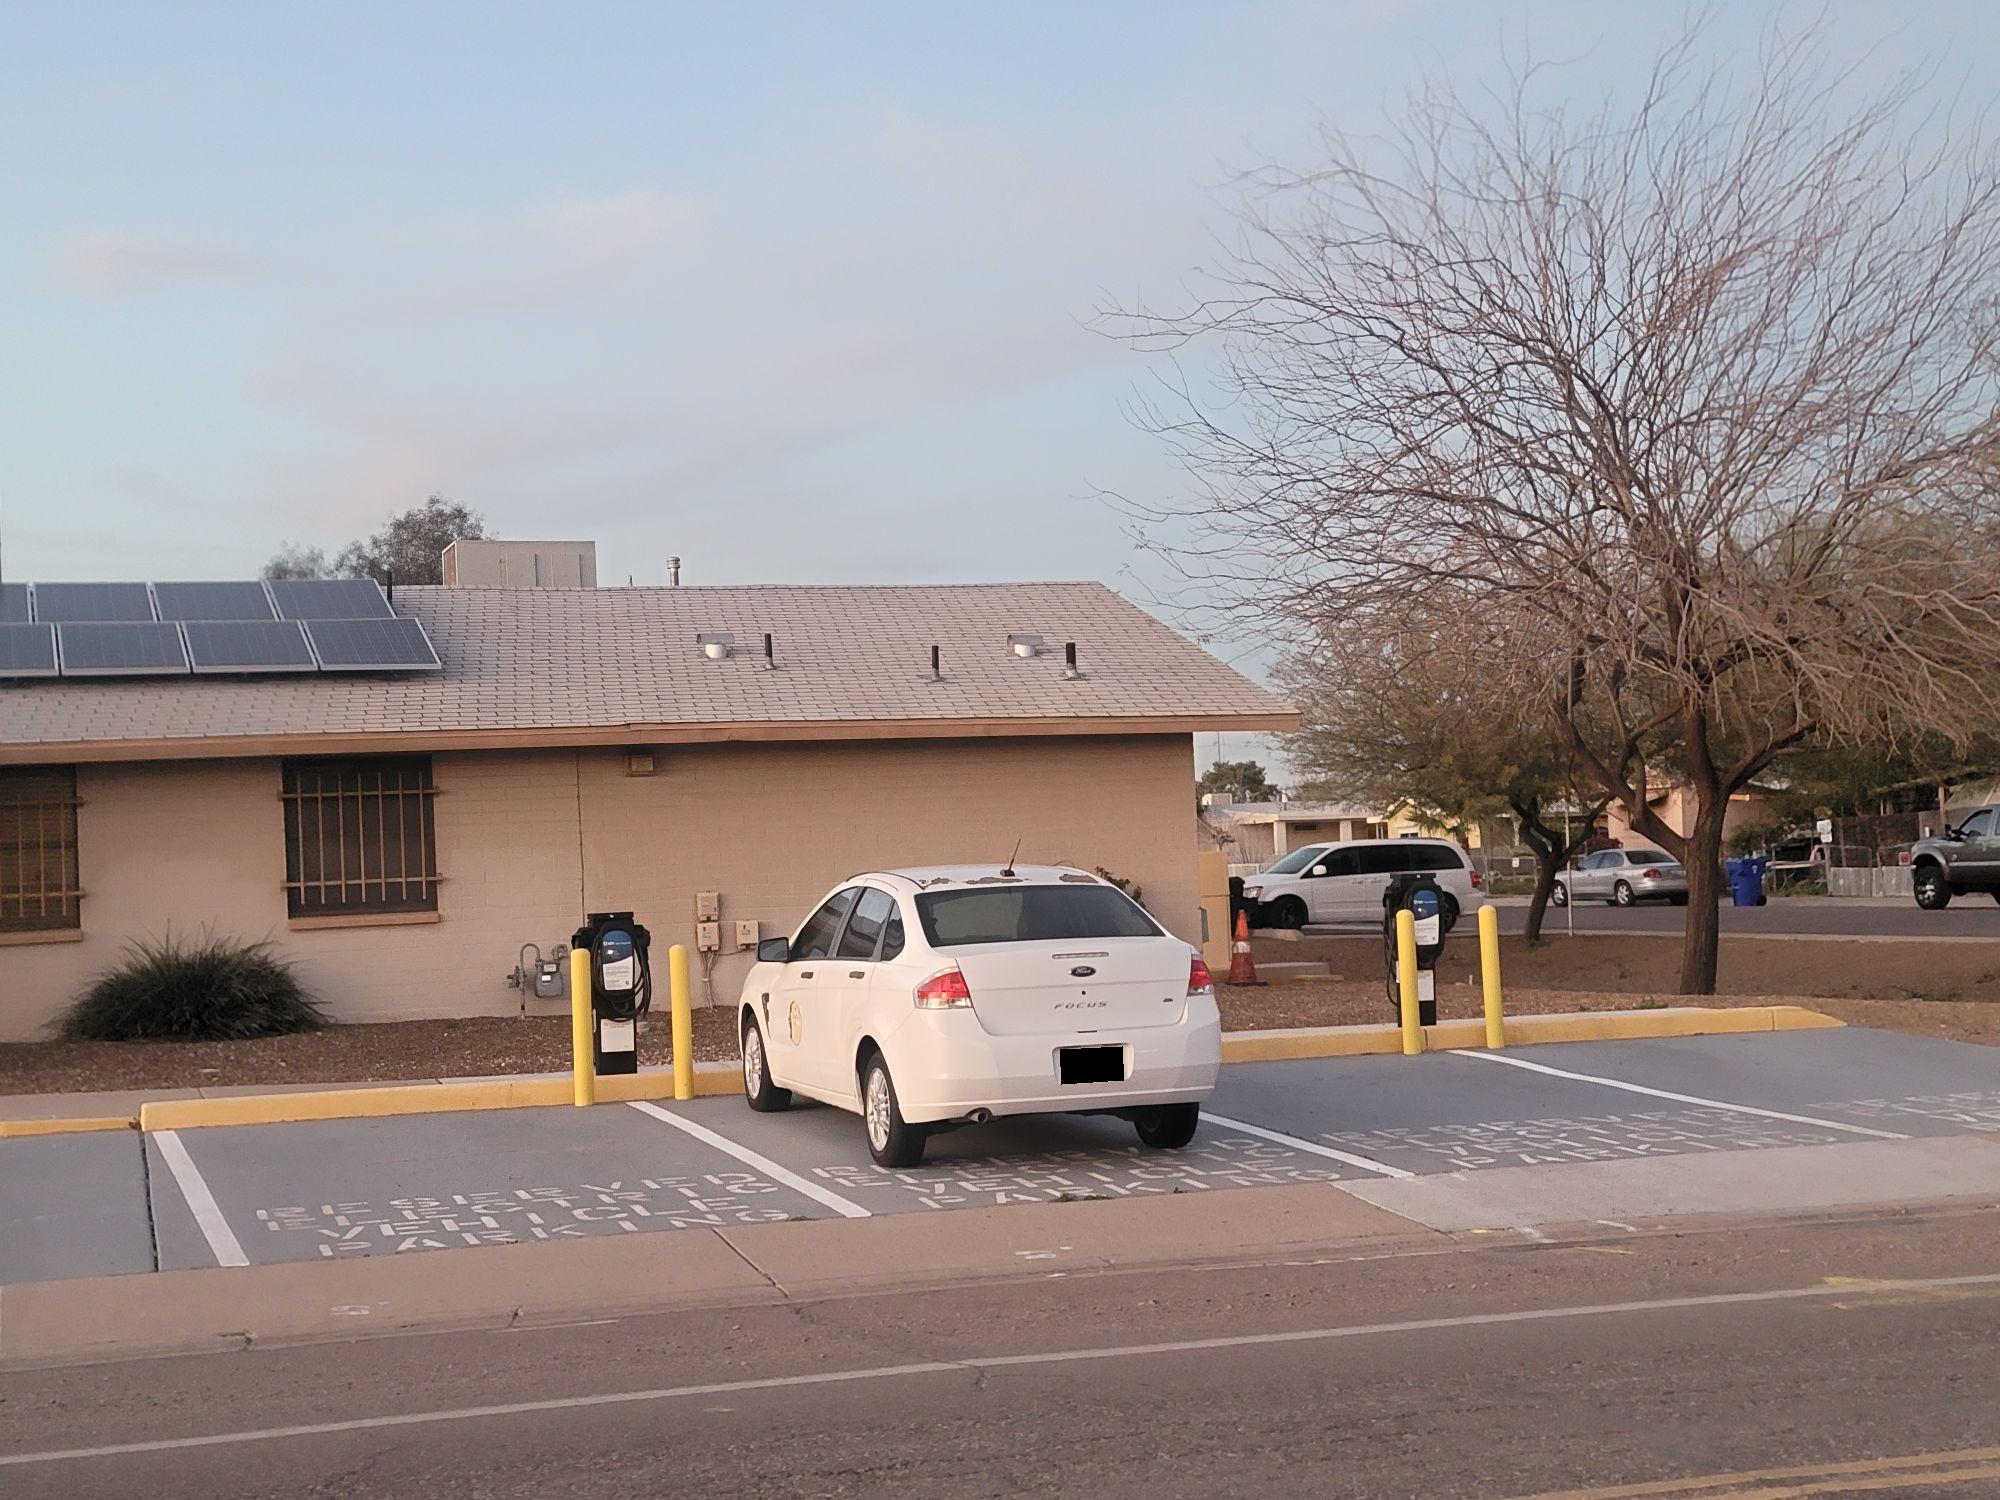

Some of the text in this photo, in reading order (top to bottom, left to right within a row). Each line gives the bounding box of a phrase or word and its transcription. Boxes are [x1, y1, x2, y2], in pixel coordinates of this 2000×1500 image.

[1054, 1002, 1107, 1010] FOCUS
[256, 1173, 757, 1220] RESERVED
[902, 1159, 1295, 1194] VEHICLE
[919, 1169, 1341, 1208] PARKING
[267, 1183, 778, 1231] ELECTRIC
[317, 1197, 750, 1239] VEHICLE
[318, 1210, 789, 1257] PARKING
